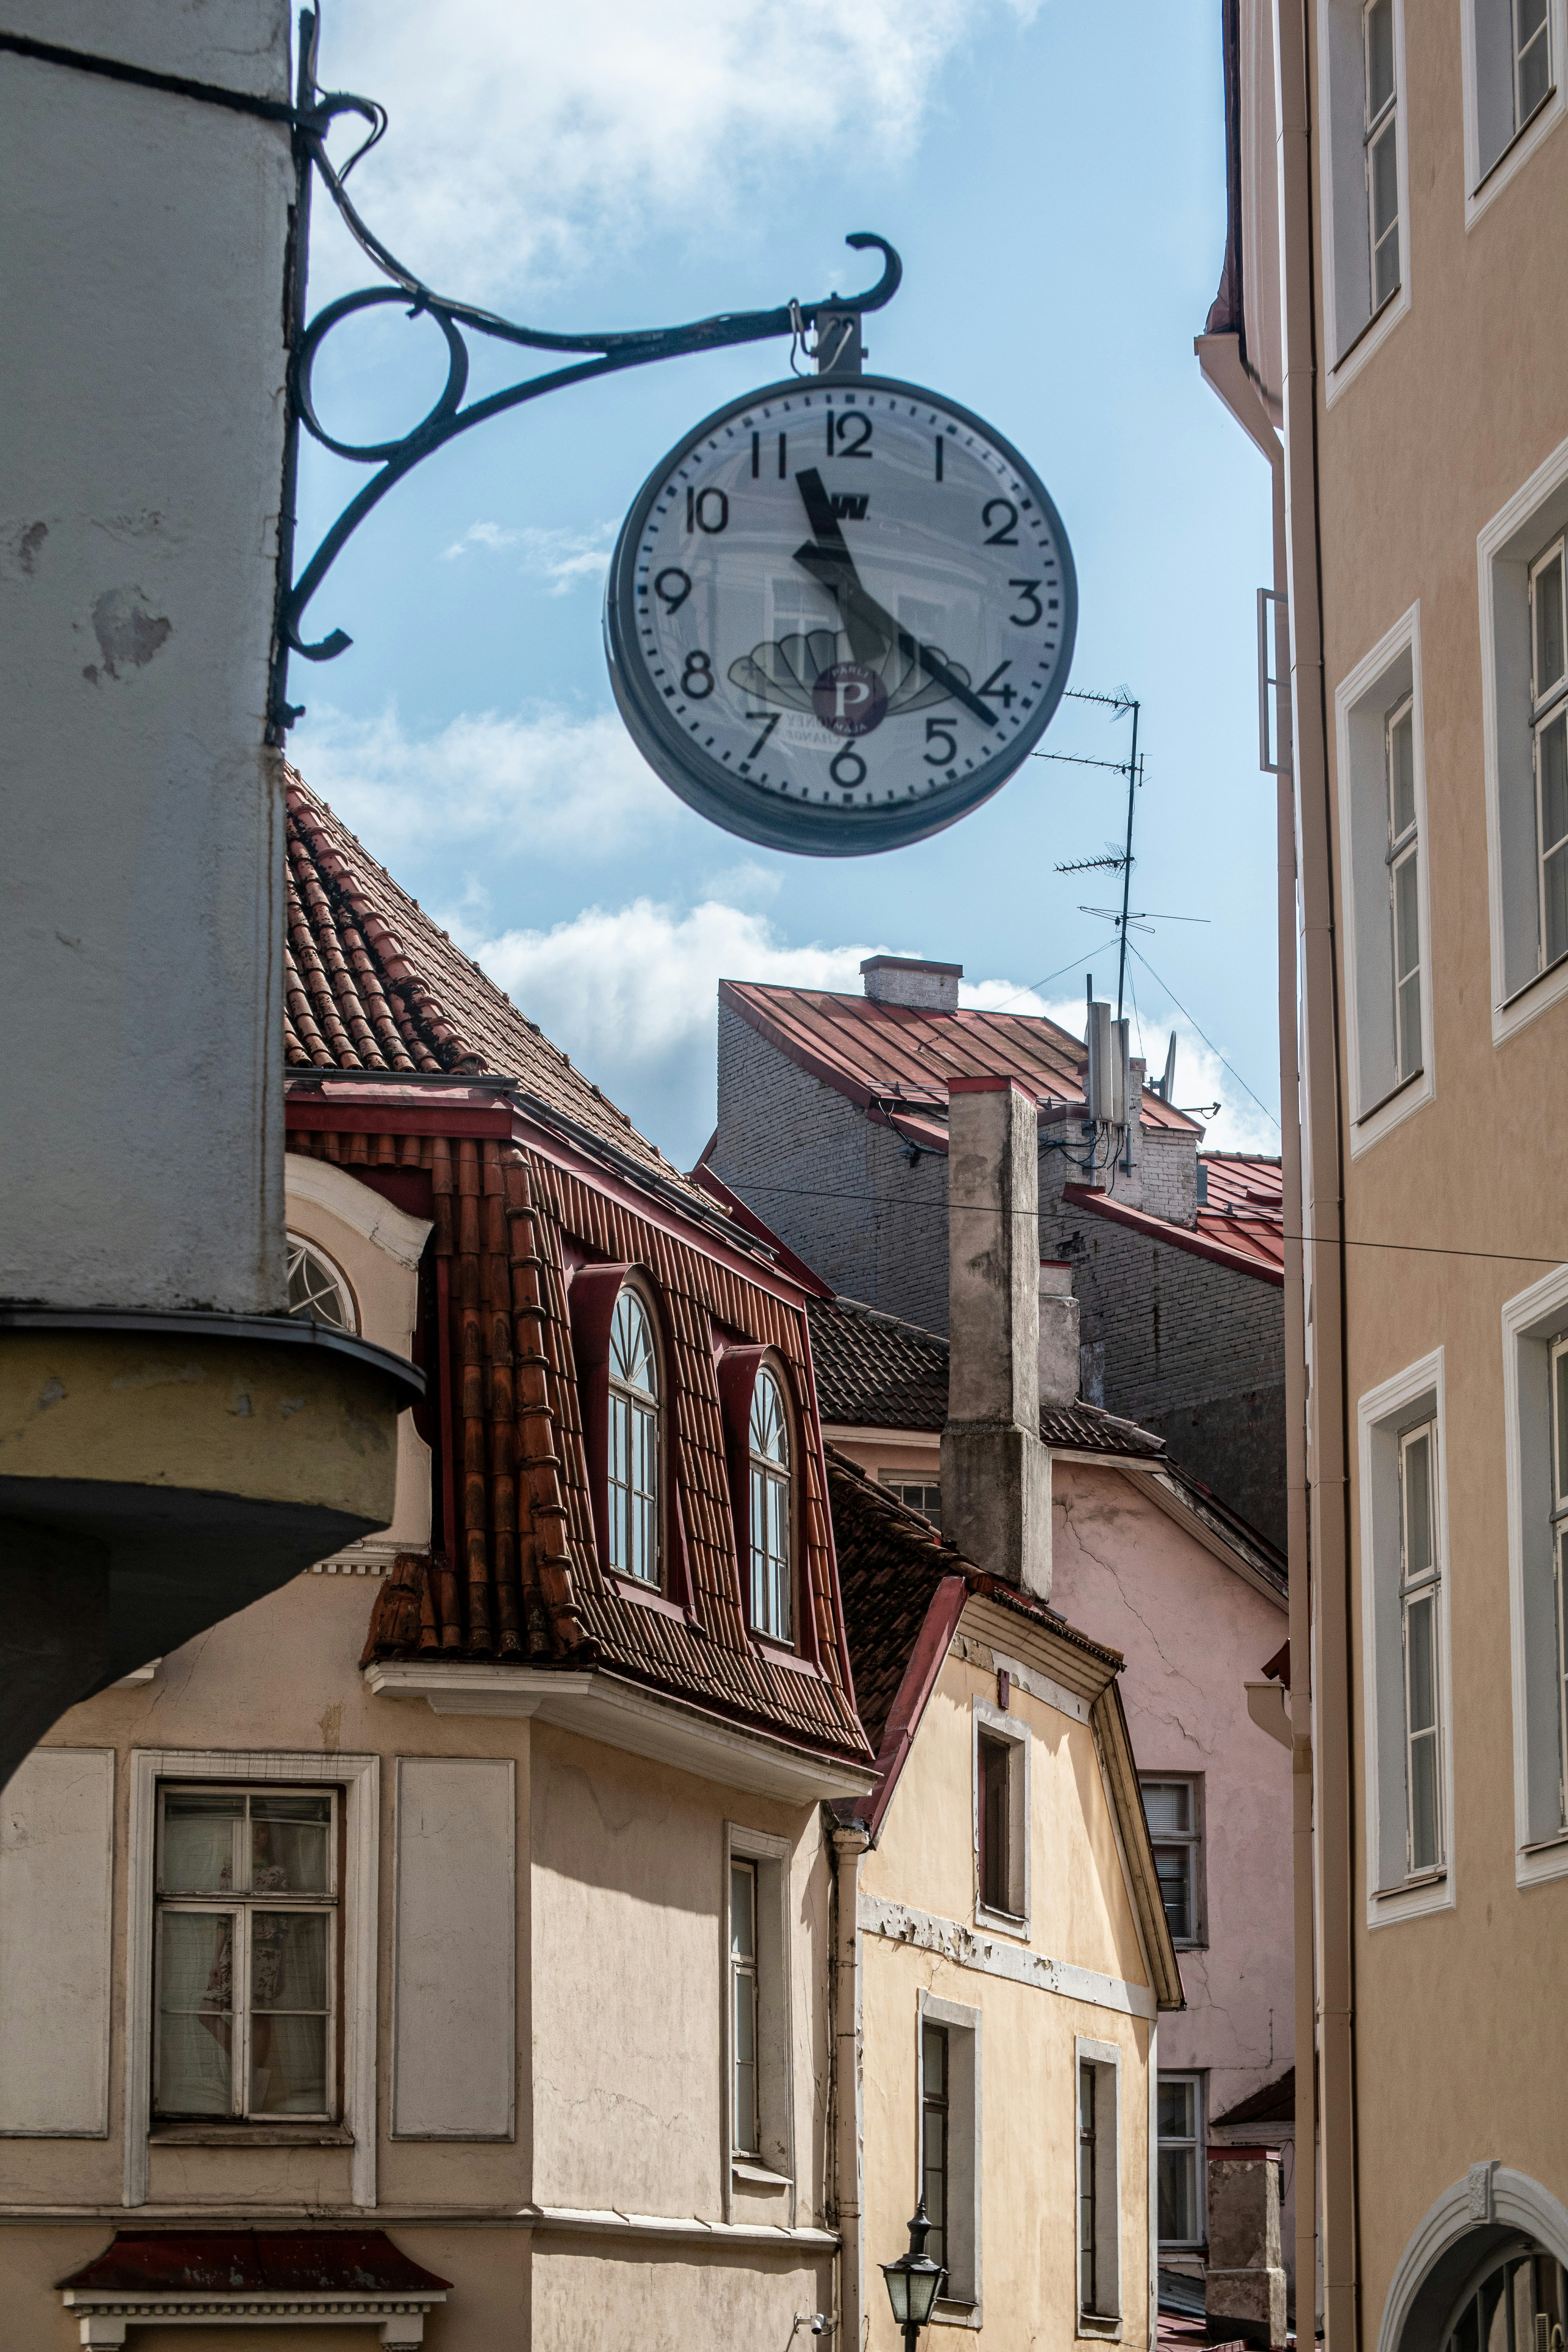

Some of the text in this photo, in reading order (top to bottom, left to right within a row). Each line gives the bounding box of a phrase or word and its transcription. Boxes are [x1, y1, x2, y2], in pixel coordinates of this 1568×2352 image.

[752, 432, 786, 479] 11
[827, 410, 873, 458] 12
[936, 435, 943, 482] 1
[687, 486, 729, 534] 10
[982, 498, 1019, 546] 2
[654, 567, 691, 615] 9
[1009, 579, 1042, 626] 3
[681, 650, 714, 699] 8
[979, 661, 1017, 708] 4
[835, 682, 869, 717] P
[746, 713, 781, 759] 7
[923, 718, 957, 766] 5
[830, 740, 867, 788] 6
